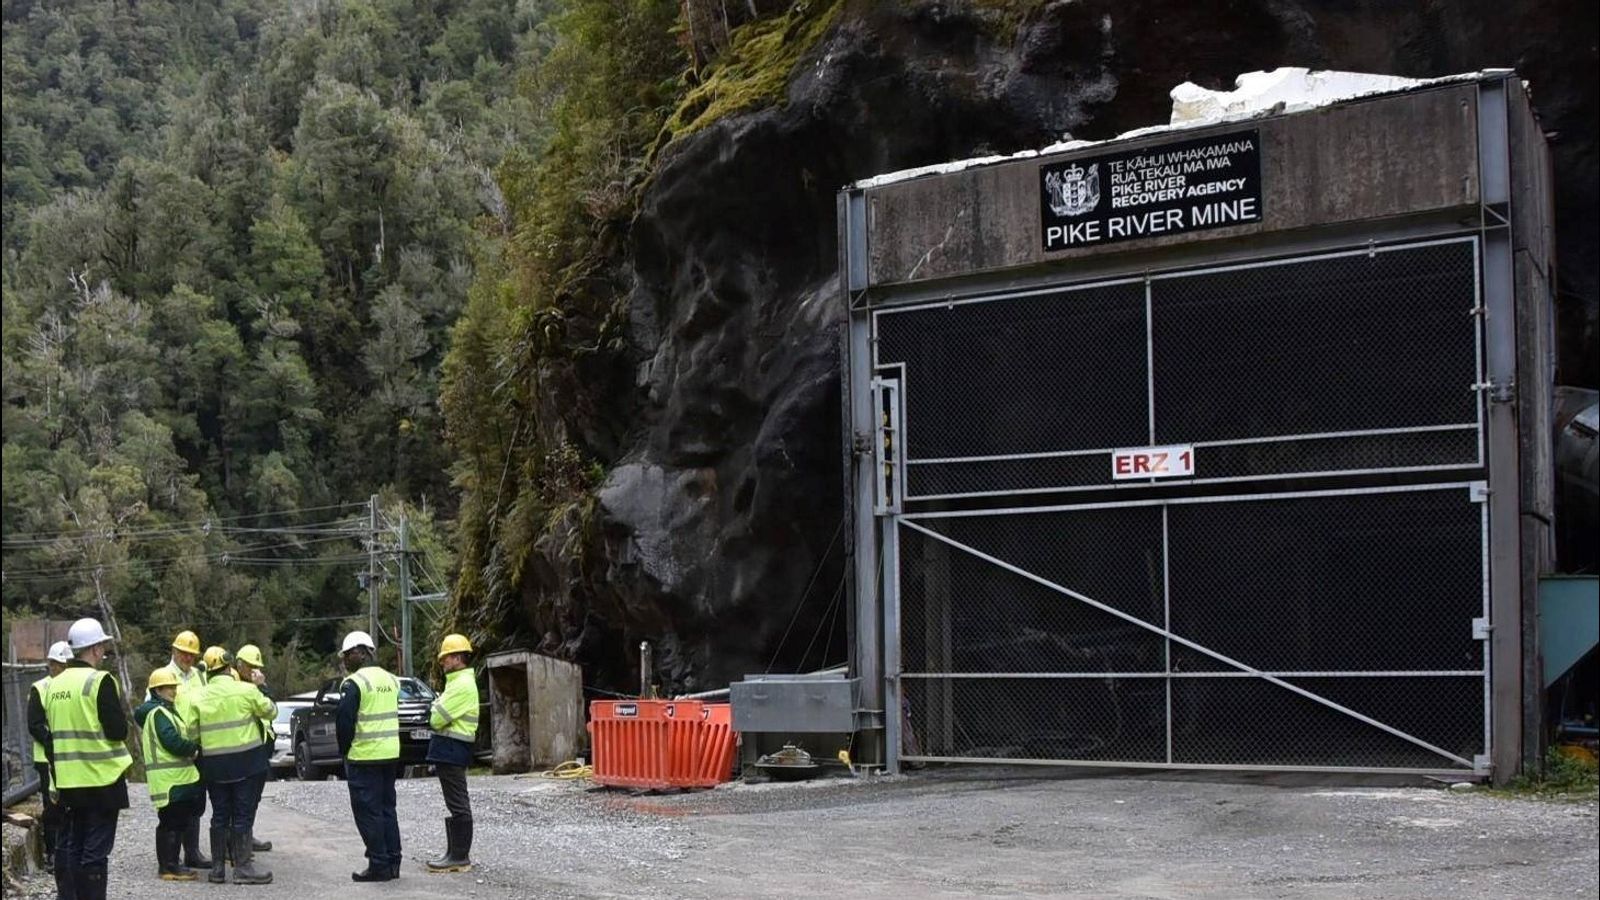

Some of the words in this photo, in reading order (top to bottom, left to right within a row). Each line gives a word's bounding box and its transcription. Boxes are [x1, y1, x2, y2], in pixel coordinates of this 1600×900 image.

[1108, 161, 1124, 174] TE
[1168, 140, 1253, 162] WHAKAMANA
[1111, 169, 1139, 185] RUA
[1139, 165, 1181, 181] TEKAU
[1207, 155, 1231, 168] IWA
[1111, 182, 1142, 196] PIKE
[1145, 175, 1186, 190] RIVER
[1112, 189, 1186, 208] RECOVERY
[1186, 177, 1246, 198] AGENCY
[1047, 220, 1100, 247] PIKE
[1108, 209, 1183, 238] RIVER
[1191, 197, 1257, 226] MINE
[1116, 453, 1169, 474] ERZ
[1179, 451, 1190, 471] 1
